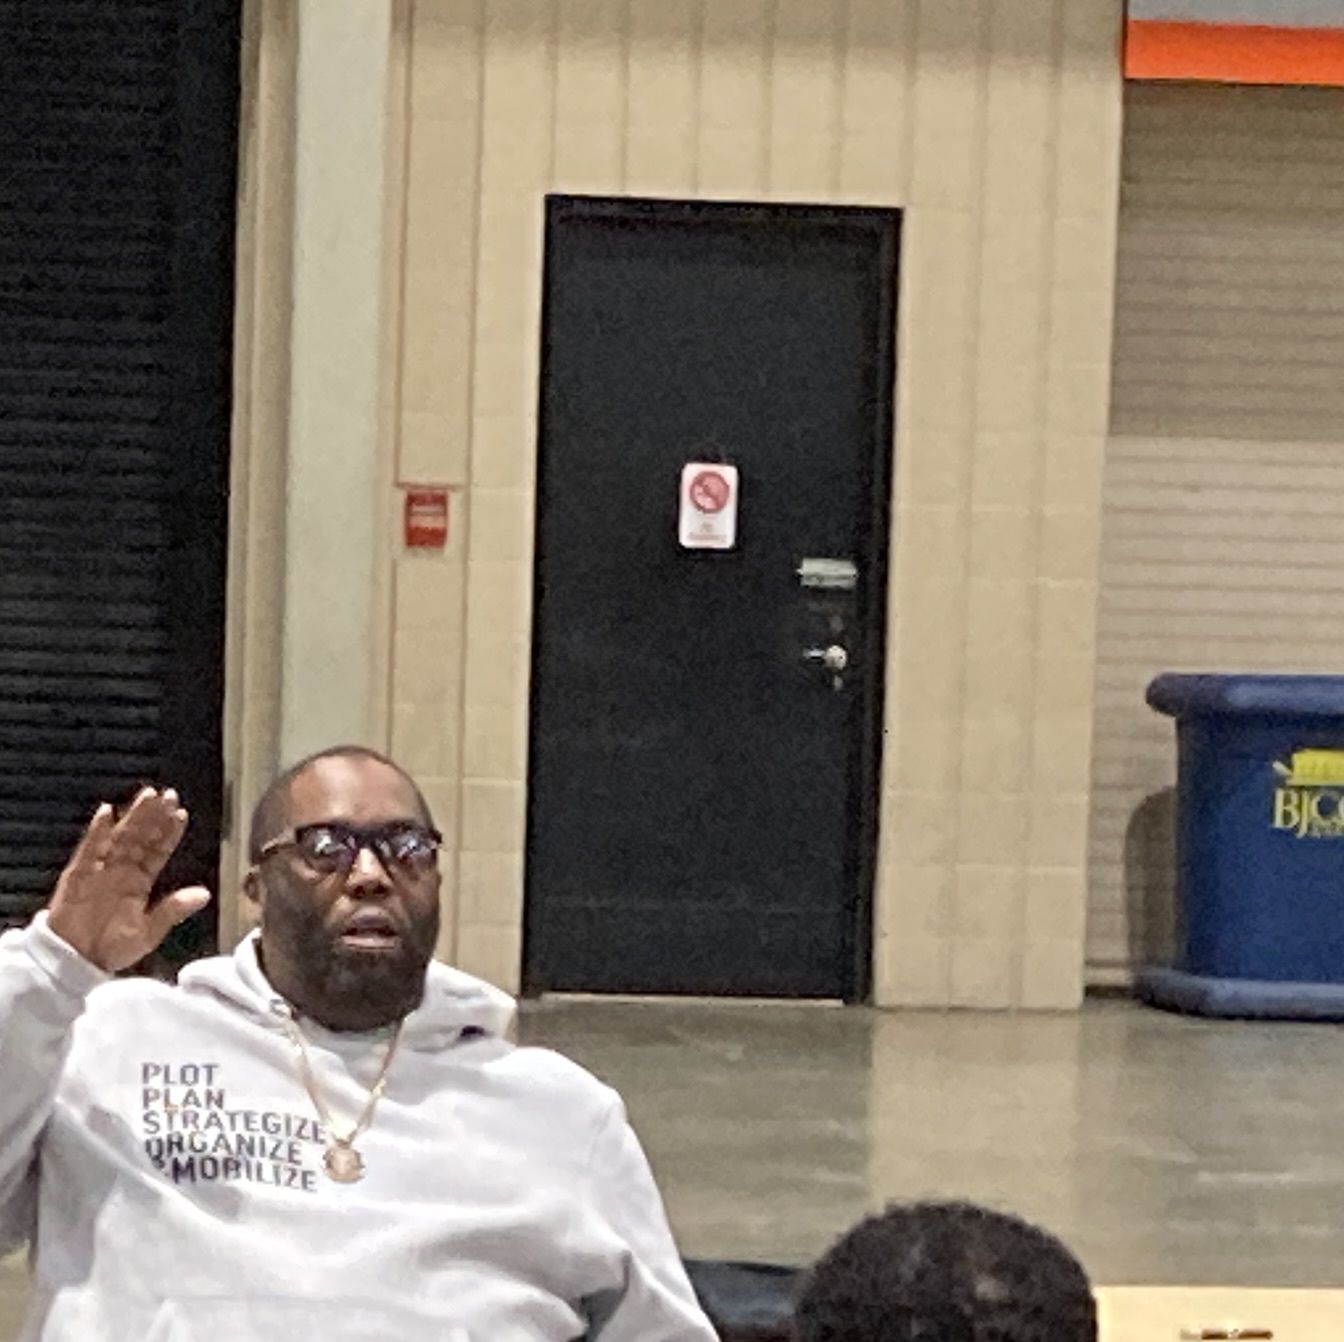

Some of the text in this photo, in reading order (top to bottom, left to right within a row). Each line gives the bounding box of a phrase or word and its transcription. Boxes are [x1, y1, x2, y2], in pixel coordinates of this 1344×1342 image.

[142, 1062, 219, 1086] PLOT
[142, 1088, 225, 1110] PLAN
[143, 1109, 327, 1145] STRATEGIZE
[145, 1131, 304, 1165] ORGANIZE
[172, 1156, 317, 1190] MOBILIZE
